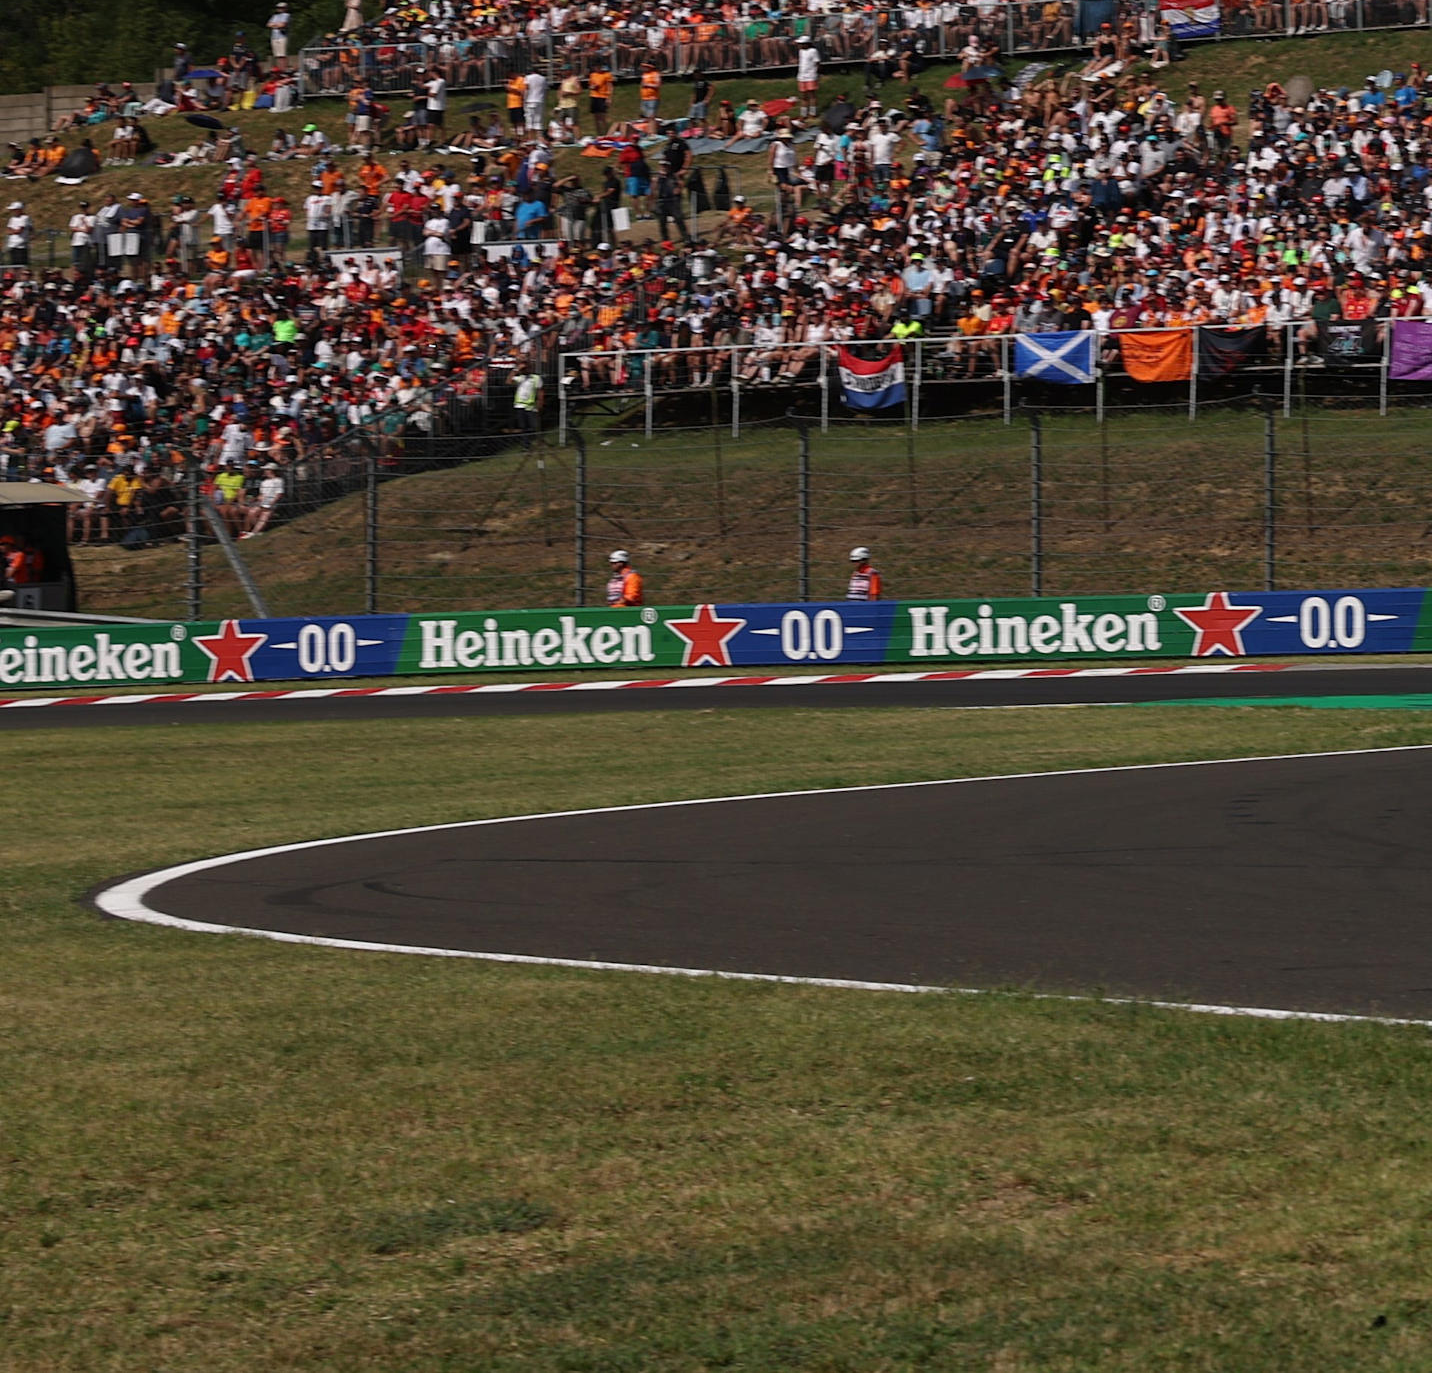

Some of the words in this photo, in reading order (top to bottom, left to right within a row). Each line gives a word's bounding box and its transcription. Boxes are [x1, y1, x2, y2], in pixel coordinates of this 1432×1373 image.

[0, 634, 183, 683] eineken
[300, 624, 355, 672] 0.0
[420, 617, 654, 667] Heineken
[783, 610, 843, 659] 0.0
[909, 604, 1161, 656] Heineken
[1301, 597, 1364, 647] 0.0
